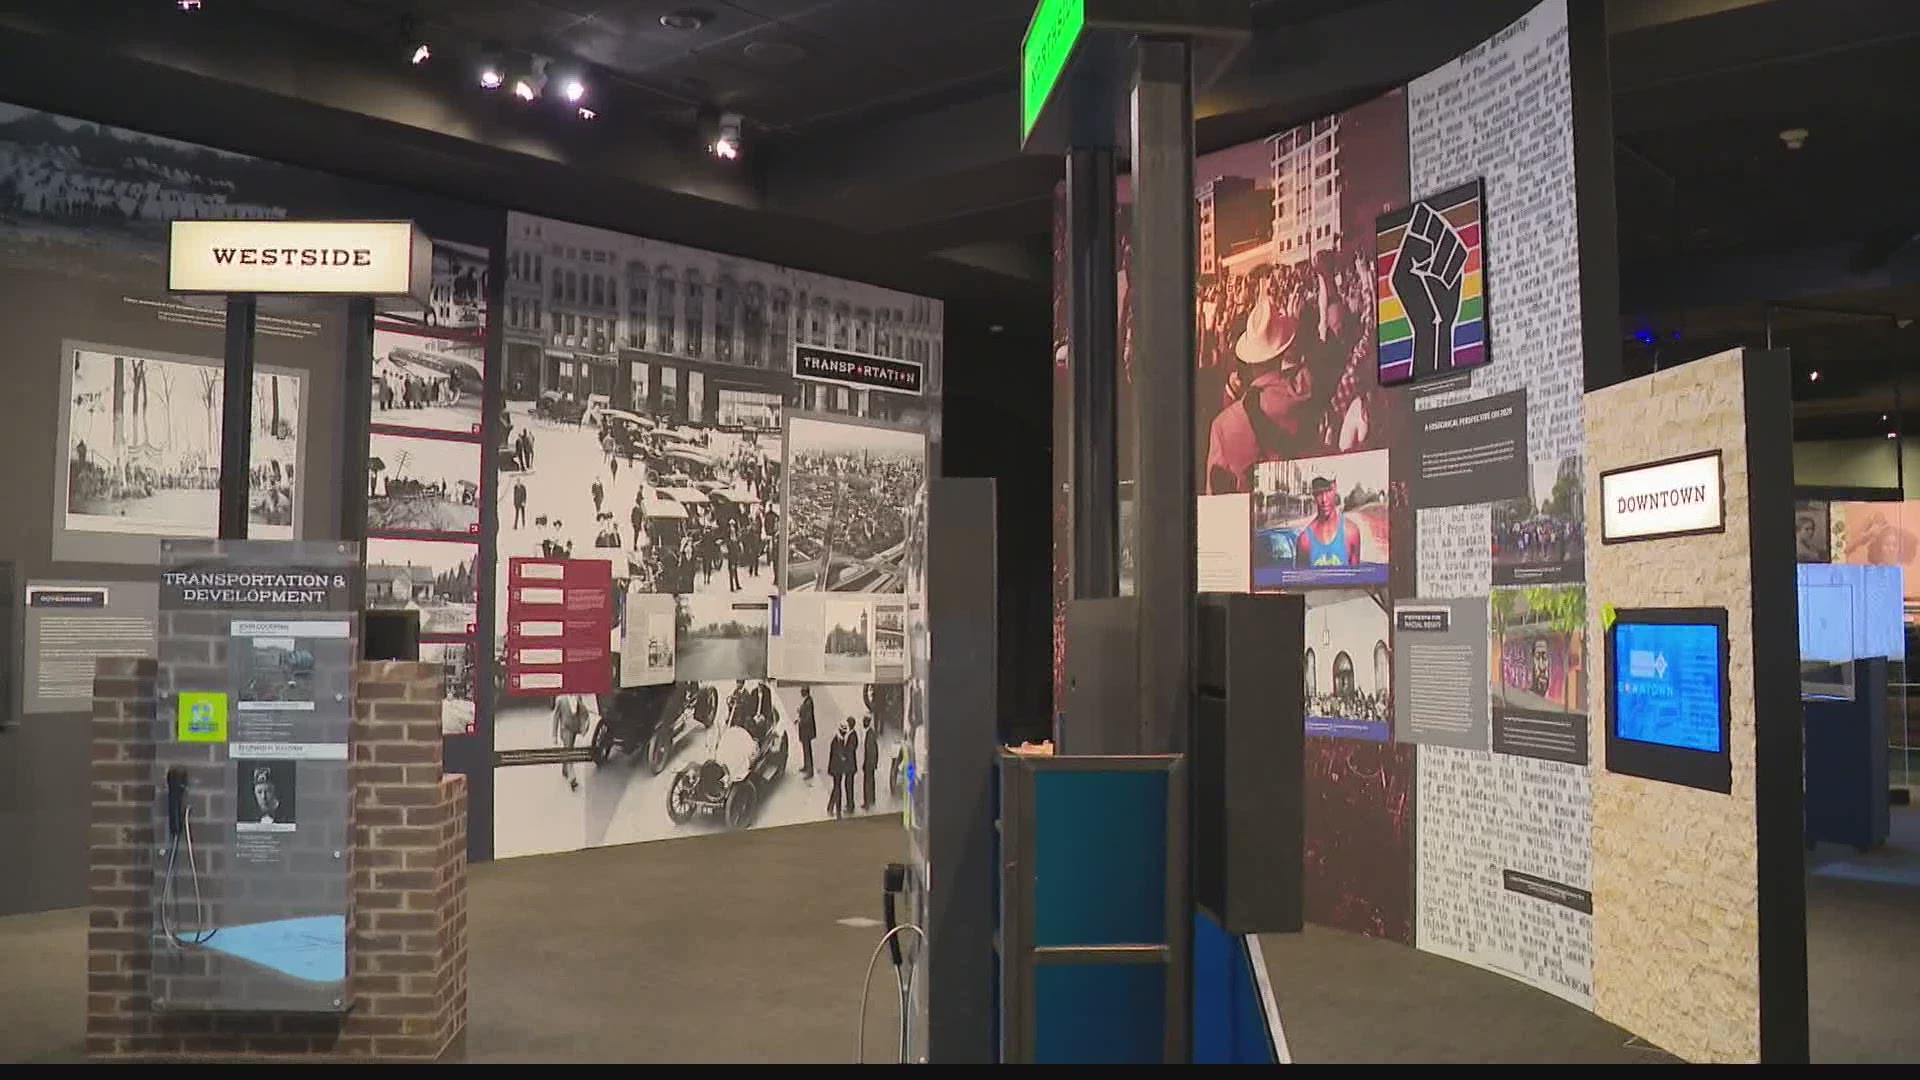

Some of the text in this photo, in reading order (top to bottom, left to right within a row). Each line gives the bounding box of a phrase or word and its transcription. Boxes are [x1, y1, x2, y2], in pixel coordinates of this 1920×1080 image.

[213, 249, 370, 266] WESTSIDE
[1459, 410, 1491, 426] PERSPECTIVE
[1491, 408, 1500, 419] ON
[1617, 484, 1706, 514] DOWNTOWN
[163, 573, 346, 589] TRANSPORTATION &
[183, 588, 327, 603] DEVELOPMENT
